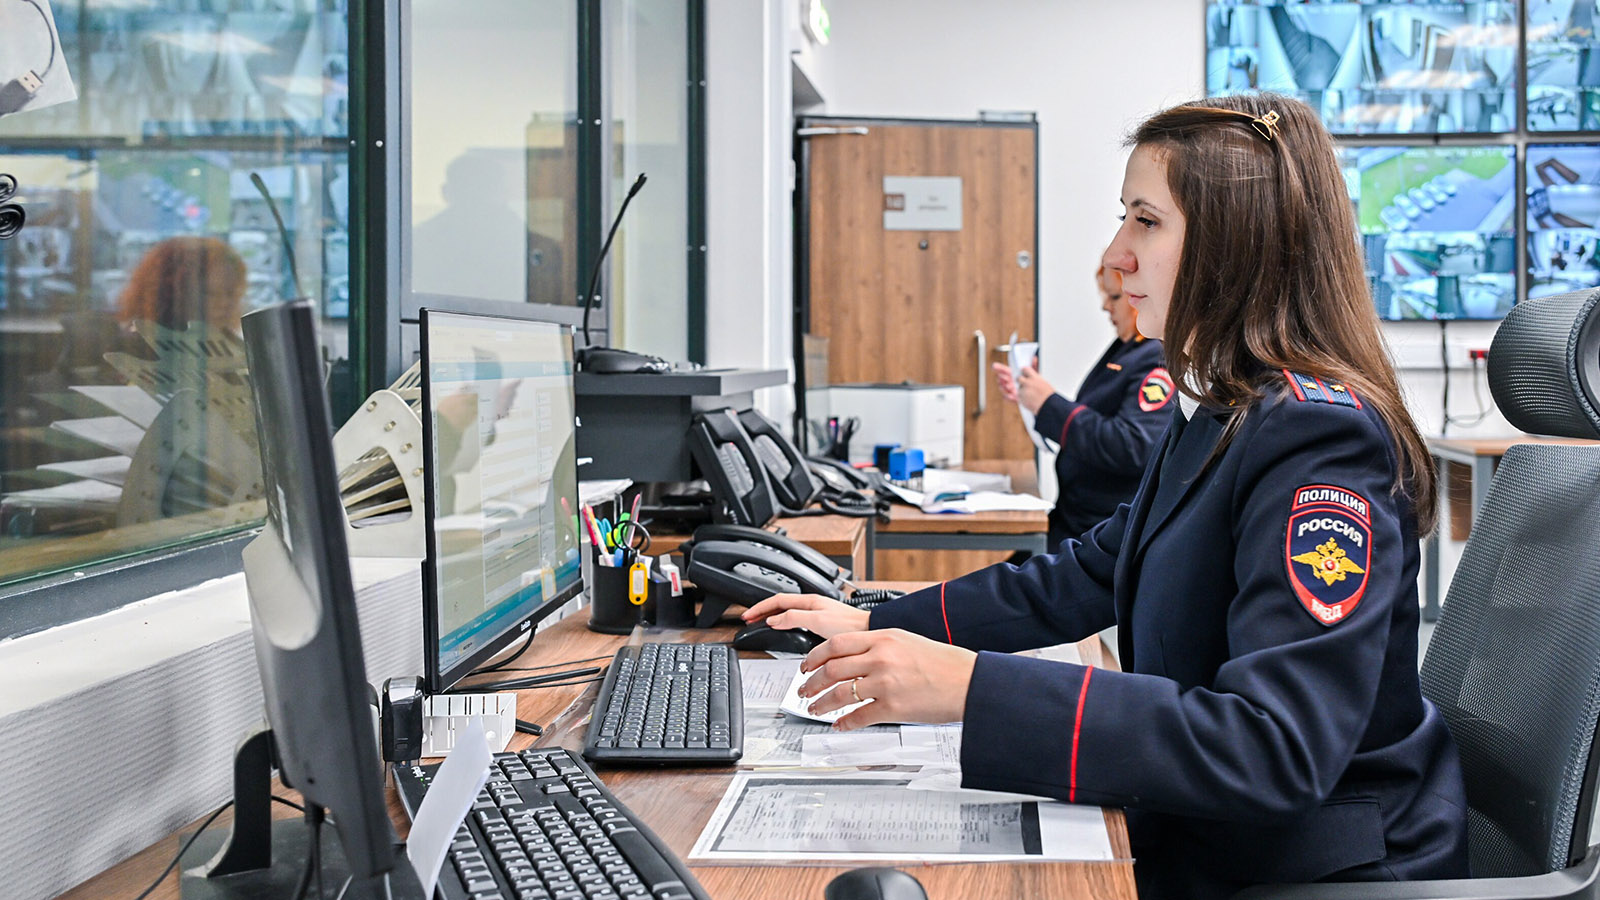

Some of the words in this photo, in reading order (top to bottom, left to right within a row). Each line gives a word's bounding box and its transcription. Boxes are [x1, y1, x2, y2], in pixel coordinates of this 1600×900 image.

[1298, 489, 1367, 516] ПОЛИЦИЯ
[1297, 518, 1364, 548] РОССИЯ
[1311, 598, 1343, 621] МВД
